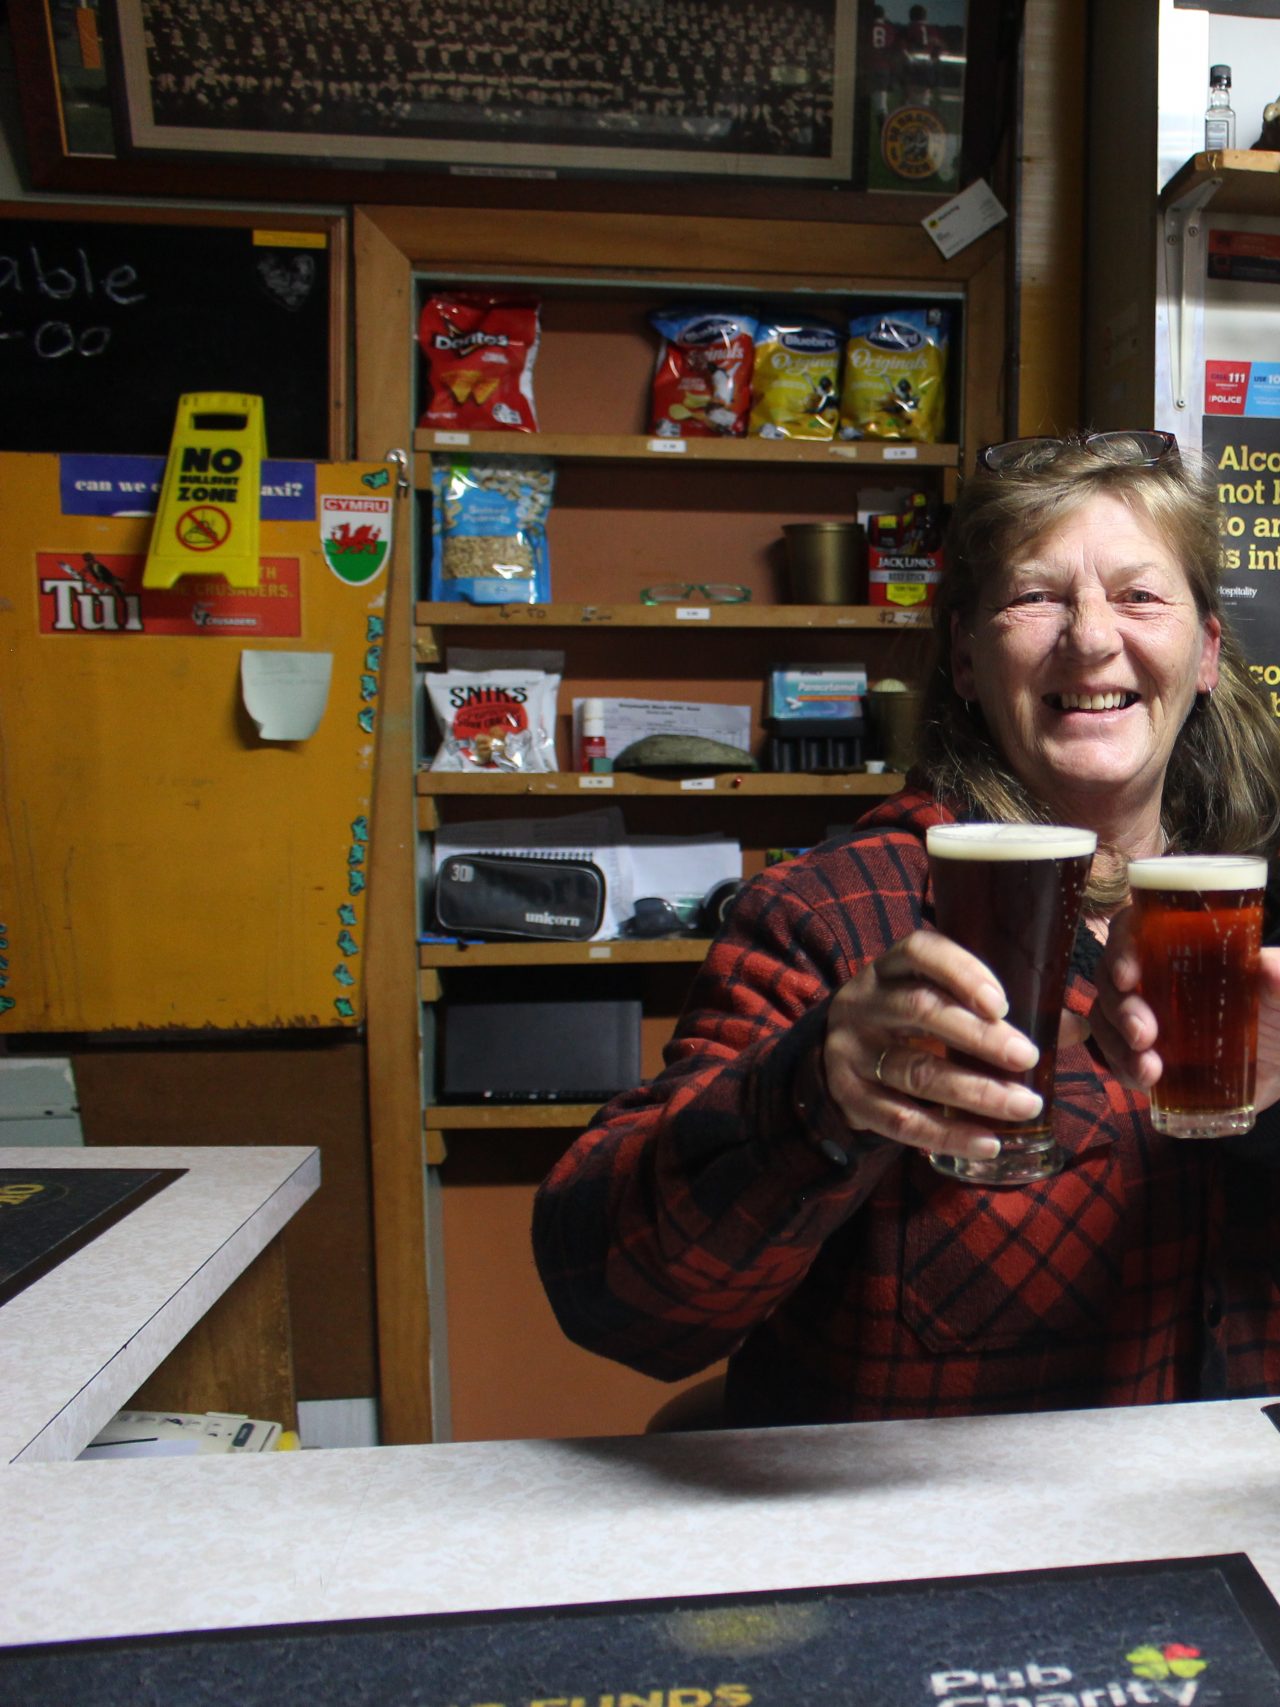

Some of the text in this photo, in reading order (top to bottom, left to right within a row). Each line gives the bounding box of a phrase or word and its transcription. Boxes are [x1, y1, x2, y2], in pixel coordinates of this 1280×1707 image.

[435, 331, 509, 350] Doritos
[1228, 373, 1246, 383] 111
[181, 448, 243, 474] NO
[75, 480, 111, 493] can
[118, 480, 147, 493] we
[260, 482, 302, 497] axi?
[1217, 481, 1265, 505] not
[177, 487, 238, 503] ZONE
[324, 499, 388, 513] CYMRU
[1219, 518, 1245, 536] o
[878, 557, 904, 569] JACK
[450, 686, 528, 708] SNIKS
[525, 911, 581, 927] unicorn
[930, 1663, 1073, 1697] Pub
